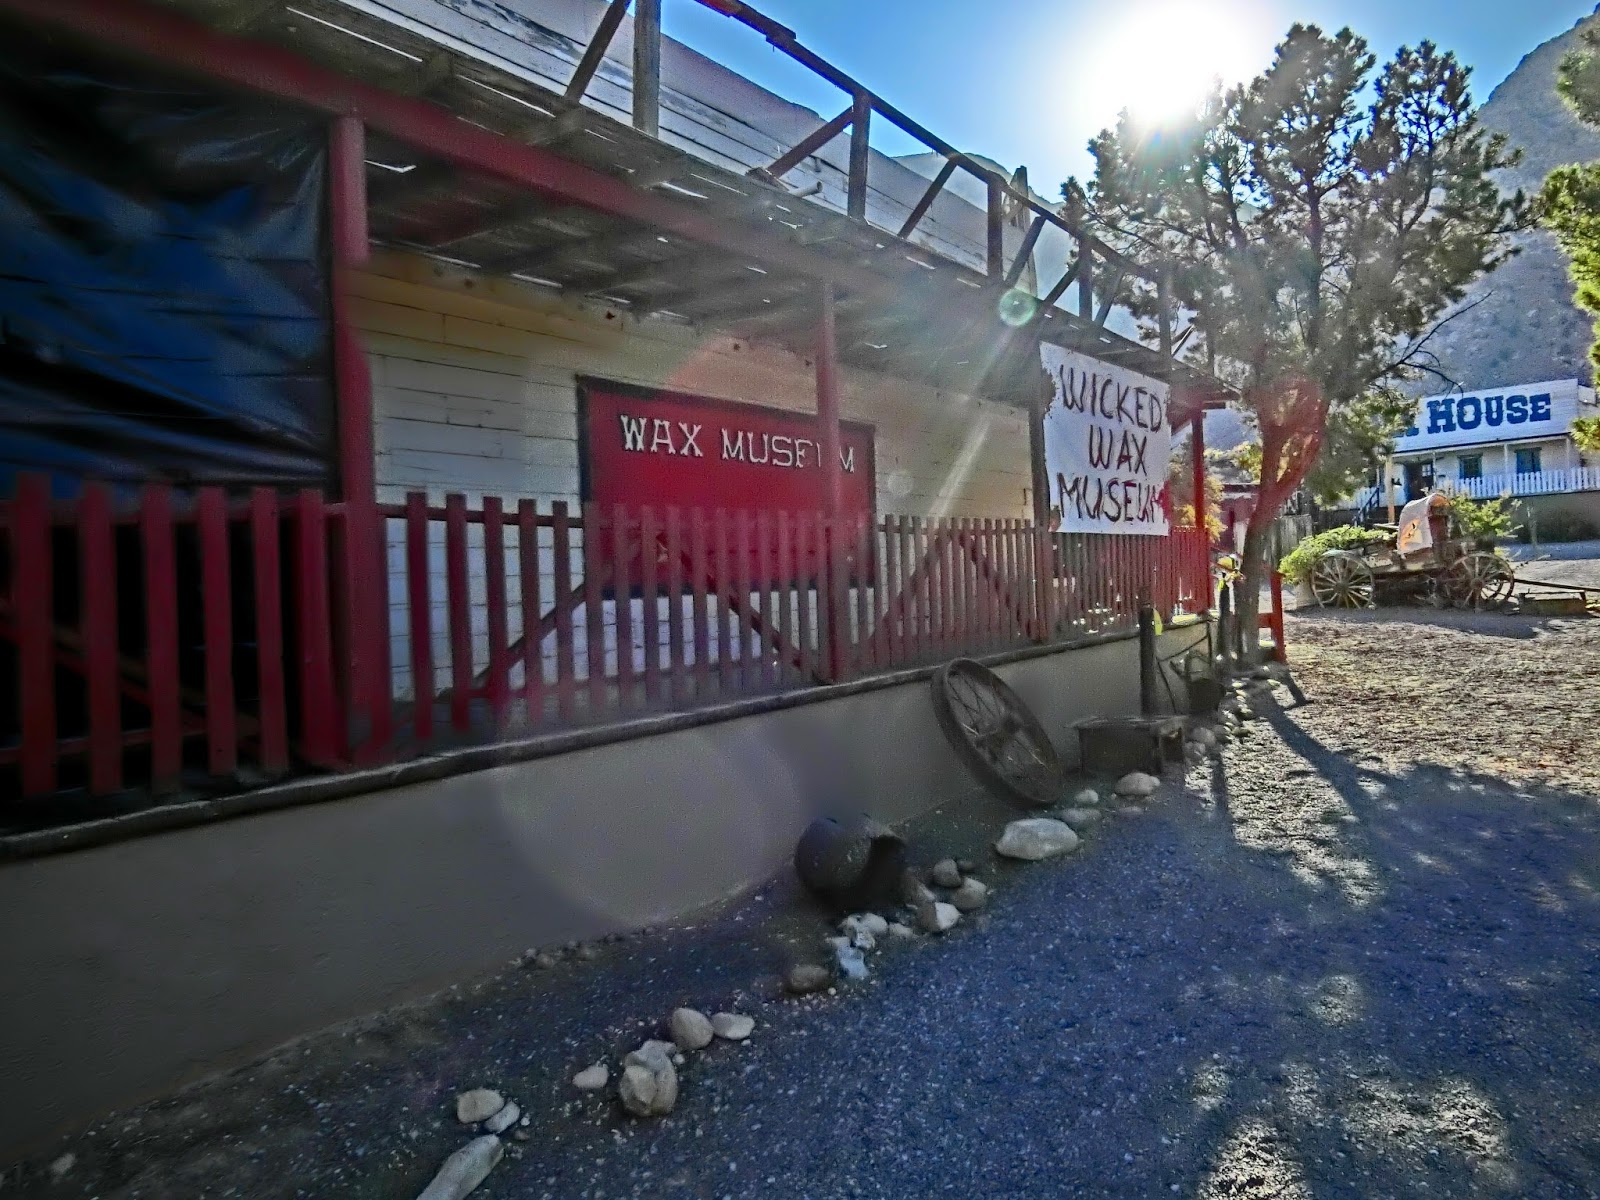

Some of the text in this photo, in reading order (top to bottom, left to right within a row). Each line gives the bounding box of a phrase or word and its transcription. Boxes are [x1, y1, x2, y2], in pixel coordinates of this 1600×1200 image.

[1059, 364, 1162, 433] WICKED
[1426, 393, 1551, 434] HOUSE
[620, 414, 854, 473] WAX MUSEM
[1088, 424, 1147, 476] WAX
